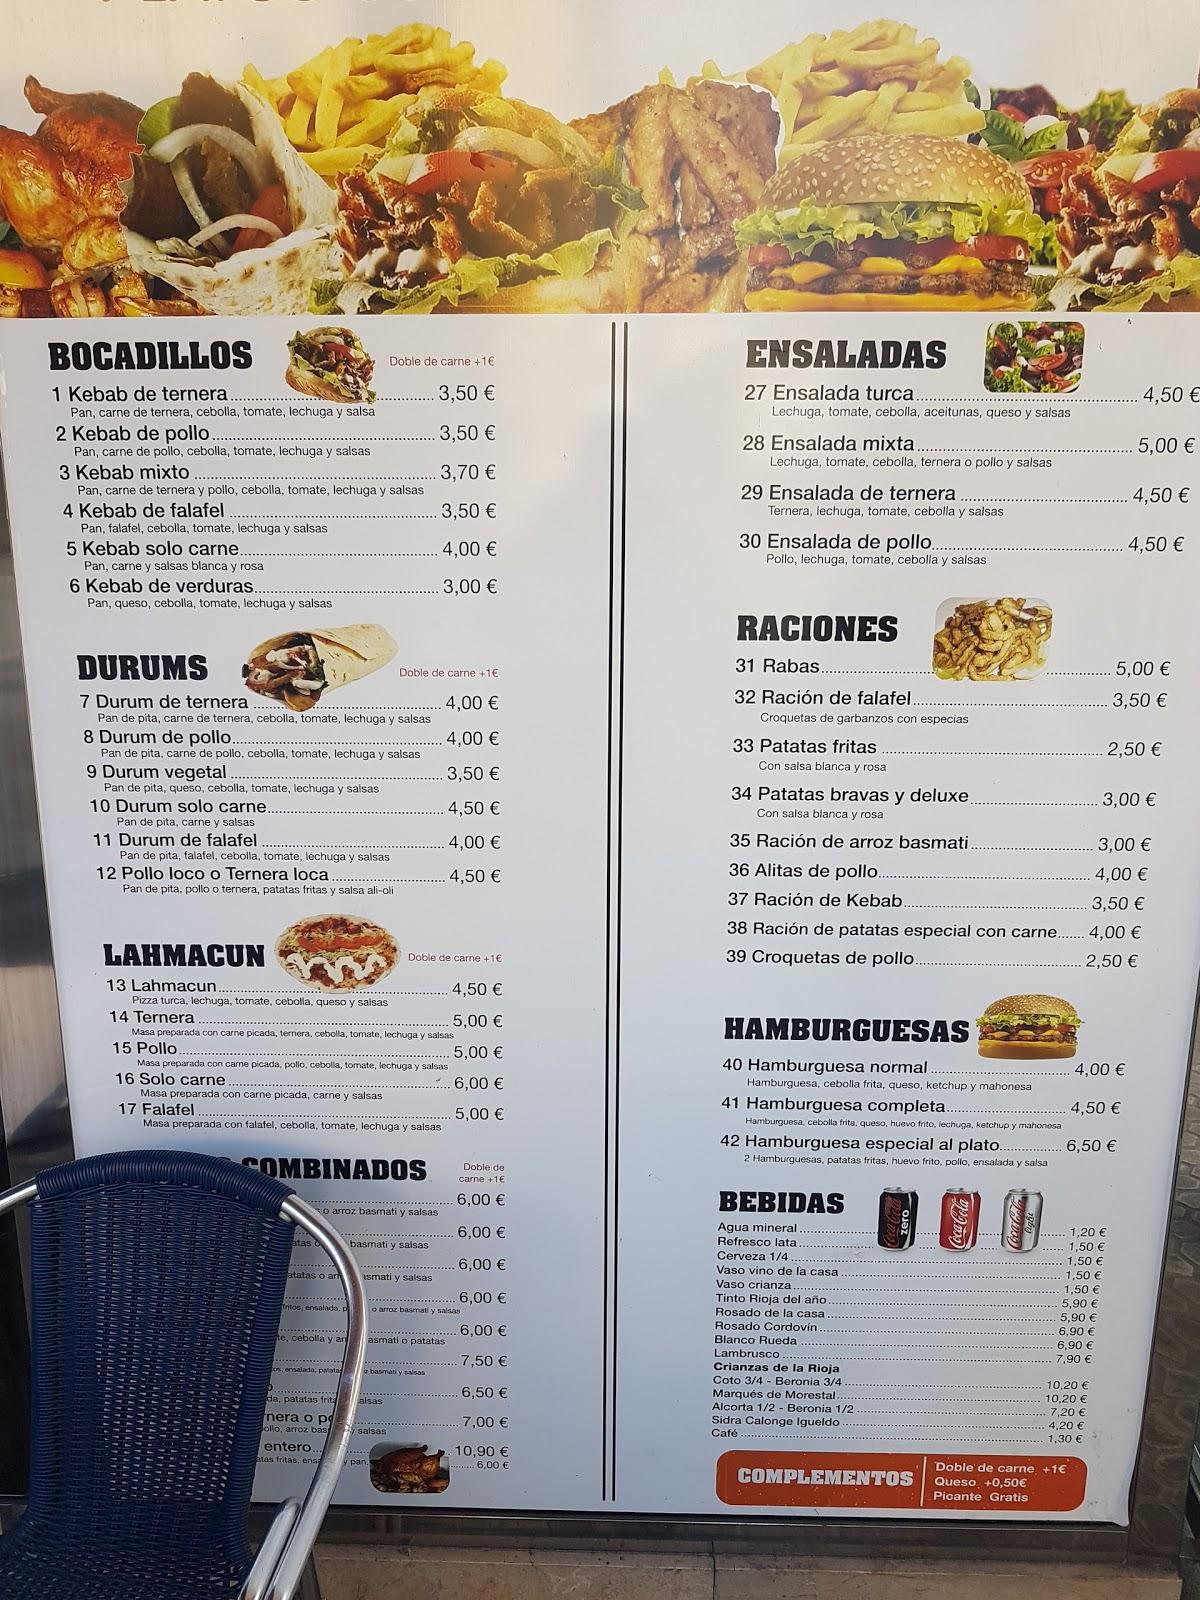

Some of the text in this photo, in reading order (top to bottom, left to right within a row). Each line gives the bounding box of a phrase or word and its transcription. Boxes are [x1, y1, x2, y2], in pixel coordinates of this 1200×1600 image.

[47, 340, 252, 370] BOCADILLOS
[389, 355, 494, 366] Doble de carne +1€
[746, 339, 946, 369] ENSALADAS
[52, 384, 495, 403] 1 Kebab de ternera 3,50 €
[70, 405, 375, 419] Pan, carne de ternera, cebolla, tomate, lechuga y salsa
[742, 434, 1195, 456] 28 Ensalada mixta 5,00 €
[59, 463, 495, 482] 3 Kebab mixto 3,70 €
[767, 505, 1004, 518] Ternera, lechuga, tomate, cebolla y salsas
[66, 540, 496, 559] 5 Kebab solo carne 4,00 €
[736, 614, 898, 642] RACIONES
[76, 654, 208, 680] DURUMS
[735, 658, 1171, 678] 31 Rabas 5,00 €
[760, 712, 968, 725] Croquetas de garbanzos con especias
[86, 764, 499, 782] 9 Durum vegetal 3,50 €
[103, 782, 379, 795] Pan de pita, queso, cebolla, tomate, lechuga y salsas
[731, 786, 1156, 808] 34 Patatas bravas y deluxe 3,00 €
[96, 866, 501, 884] 12 Pollo loco o Ternera loca 4,50 €
[102, 943, 264, 967] LAHMACUN
[109, 1010, 502, 1029] 14 Ternera 5,00 €
[724, 1017, 969, 1043] HAMBURGUESAS
[747, 1077, 1032, 1092] Hamburguesa, cebolla frita, queso, ketchup y mahonesa
[140, 1088, 167, 1097] Masa
[169, 1089, 220, 1099] preparada
[274, 1090, 310, 1100] picada,
[343, 1092, 349, 1101] y
[352, 1091, 382, 1100] salsas
[721, 1096, 1121, 1116] 41 Hamburguesa completa 4,50 €
[463, 1162, 504, 1171] Doble de
[487, 1175, 505, 1183] +1€
[718, 1190, 844, 1214] BEBIDAS
[717, 1222, 1107, 1238] Agua mineral 1,20 €
[900, 1209, 910, 1236] zero
[1024, 1212, 1036, 1234] light
[349, 1239, 429, 1250] basmati y salsas
[714, 1321, 1095, 1337] Rosado Cordovín 6,90 €
[713, 1361, 839, 1374] Crianzas de la Rioja
[711, 1415, 1085, 1430] Sidra Calonge Igueldo 4,20 €
[263, 1441, 508, 1458] entero 10,90 €
[737, 1466, 914, 1486] COMPLEMENTOS
[935, 1462, 1067, 1474] Doble de carne +1€
[934, 1476, 1028, 1490] Queso +0,50€
[934, 1491, 1029, 1503] Picante Gratis
